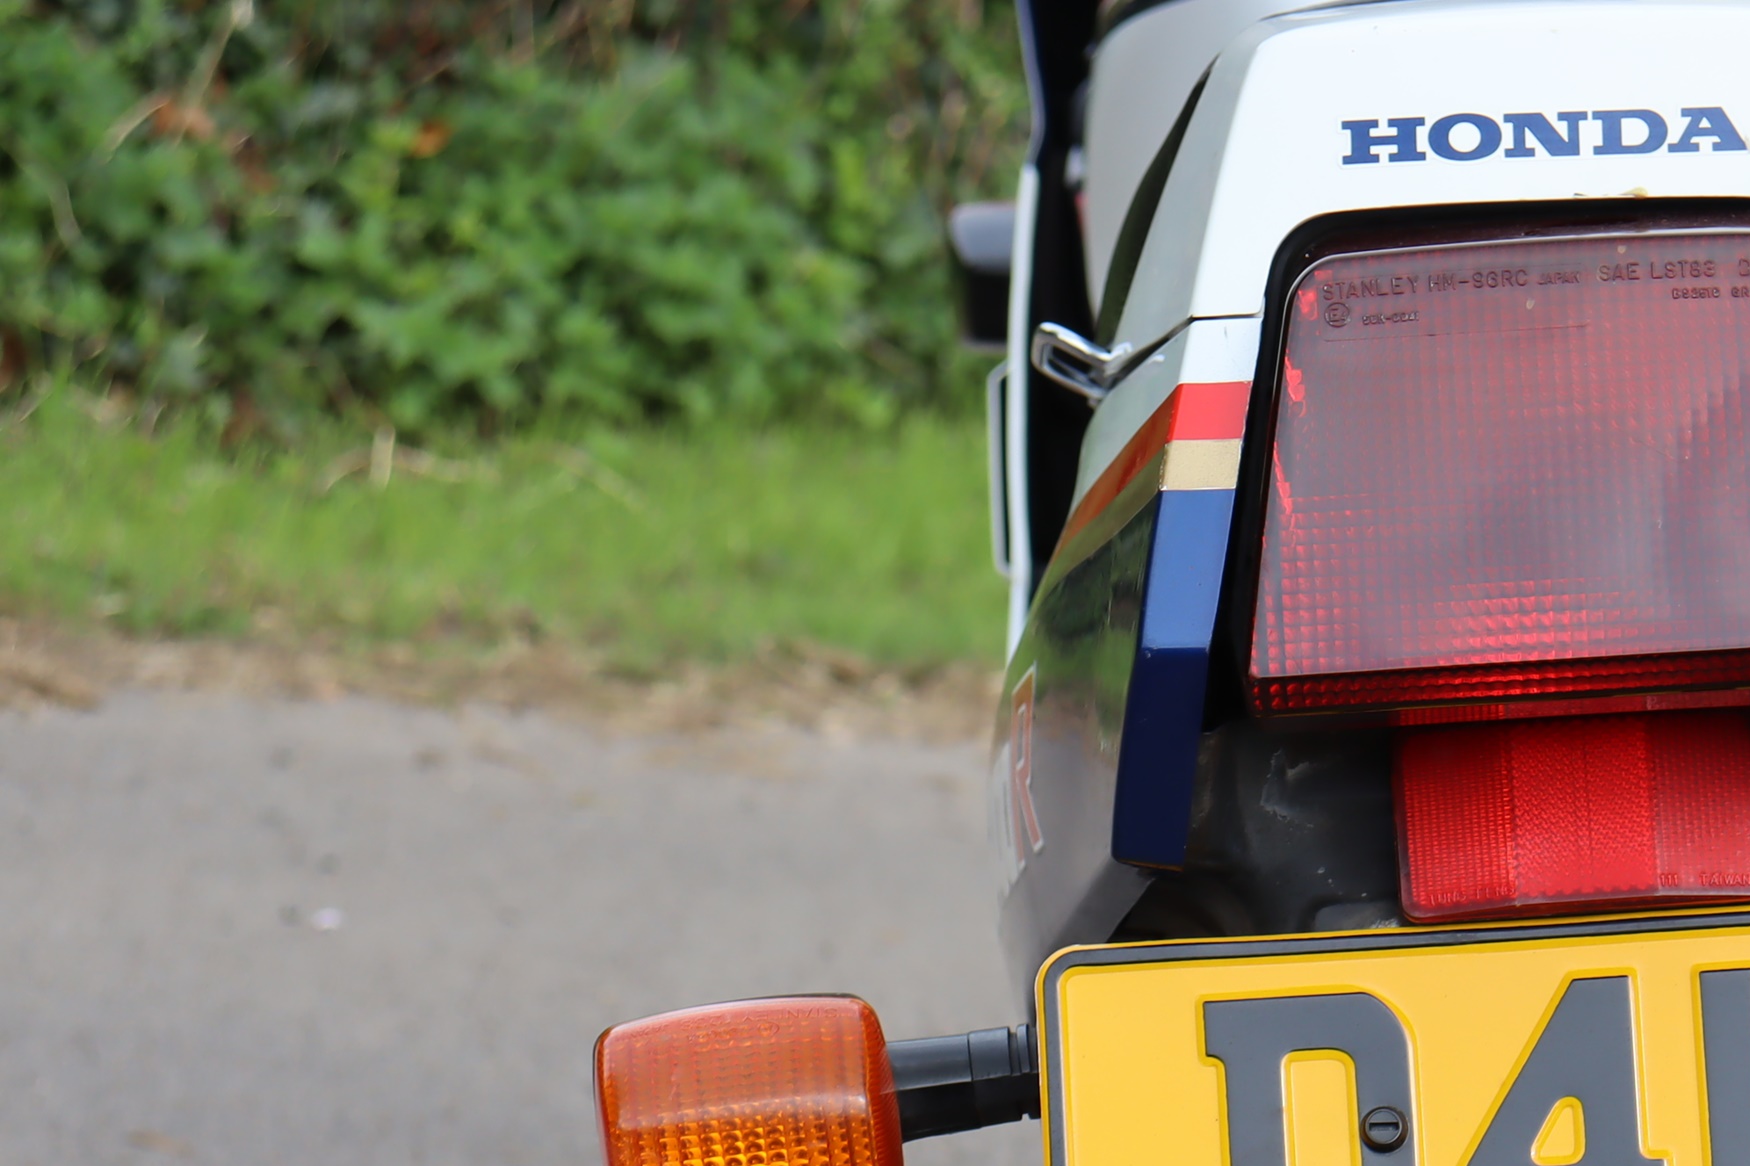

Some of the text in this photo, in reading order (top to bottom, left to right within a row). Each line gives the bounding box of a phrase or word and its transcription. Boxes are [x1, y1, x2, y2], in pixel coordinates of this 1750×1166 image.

[1341, 106, 1749, 165] HONDA
[1322, 274, 1419, 301] STANLEY
[1537, 271, 1581, 286] JAPAN
[1598, 261, 1641, 282] SAE
